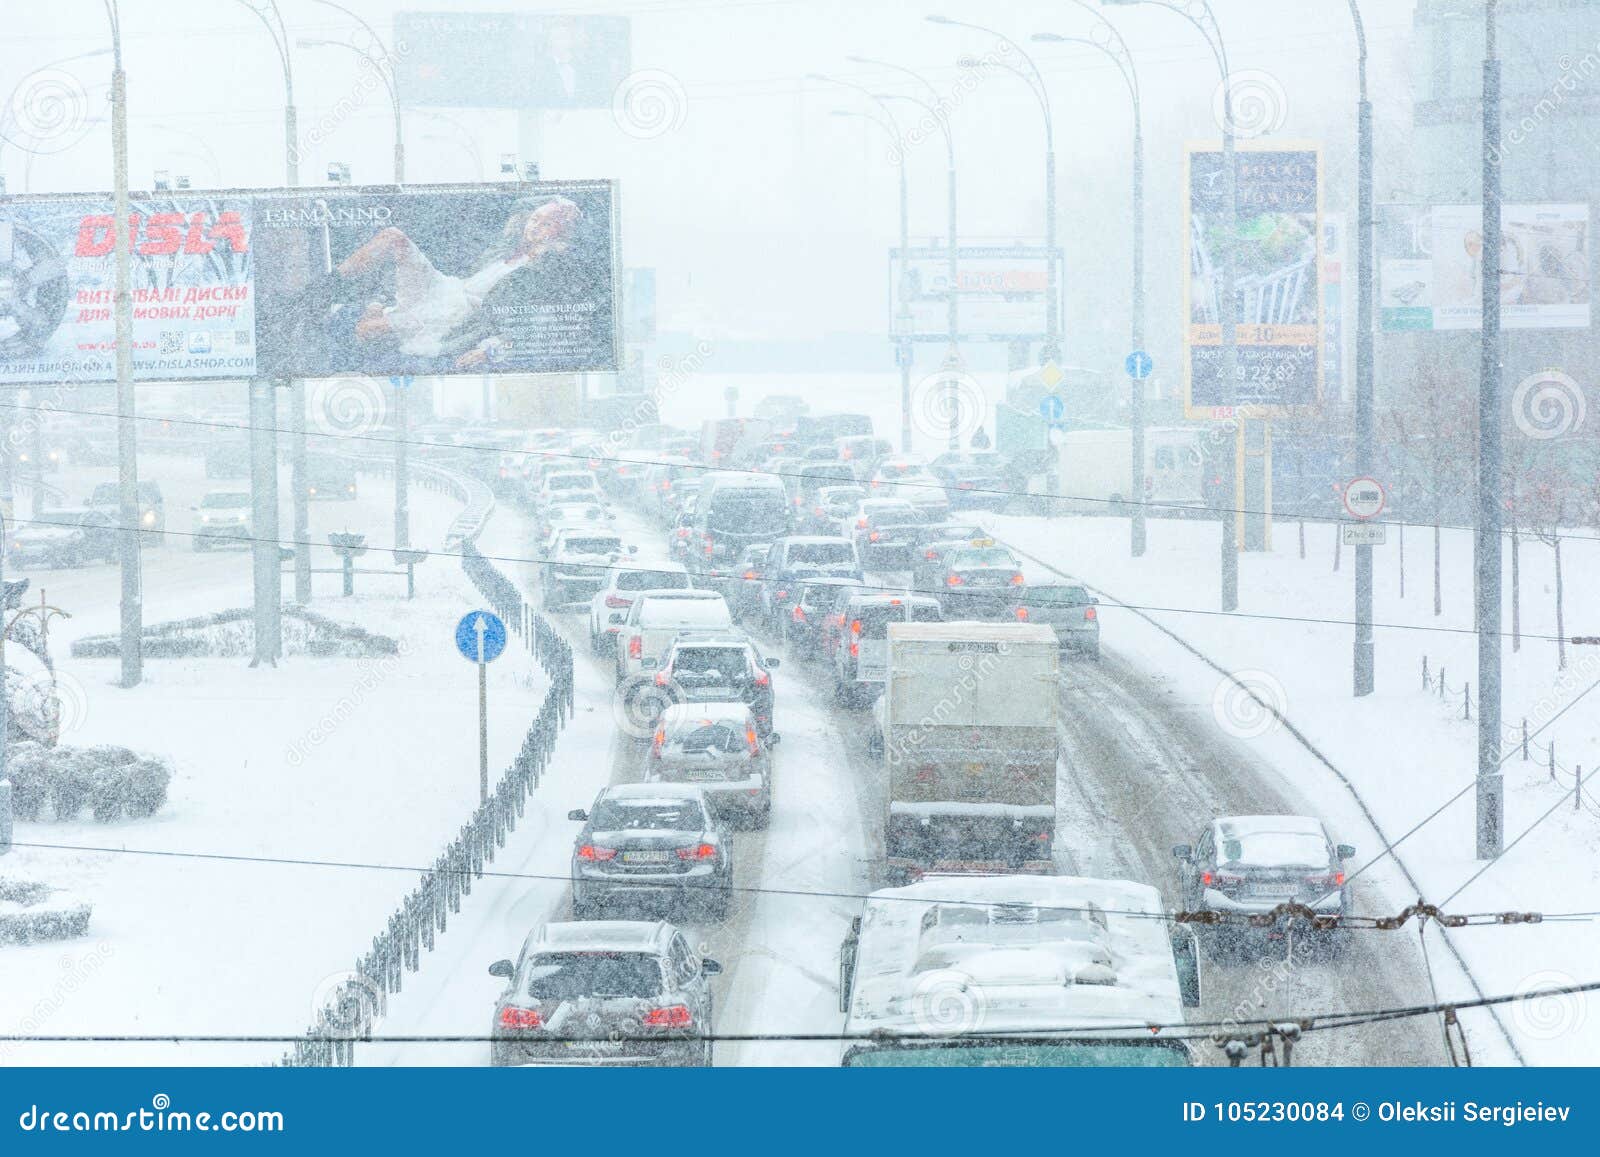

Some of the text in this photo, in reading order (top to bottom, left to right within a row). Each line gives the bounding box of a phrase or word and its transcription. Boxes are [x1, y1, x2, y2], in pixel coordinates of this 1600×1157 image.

[264, 206, 392, 222] ERMANNO
[74, 211, 248, 257] DISLA
[76, 285, 248, 305] ВИТВАЛІ ДИСКИ
[76, 307, 111, 324] ДЛЯ
[127, 306, 191, 320] МОВИХ
[131, 357, 255, 371] WW.DISLASHOP.COM
